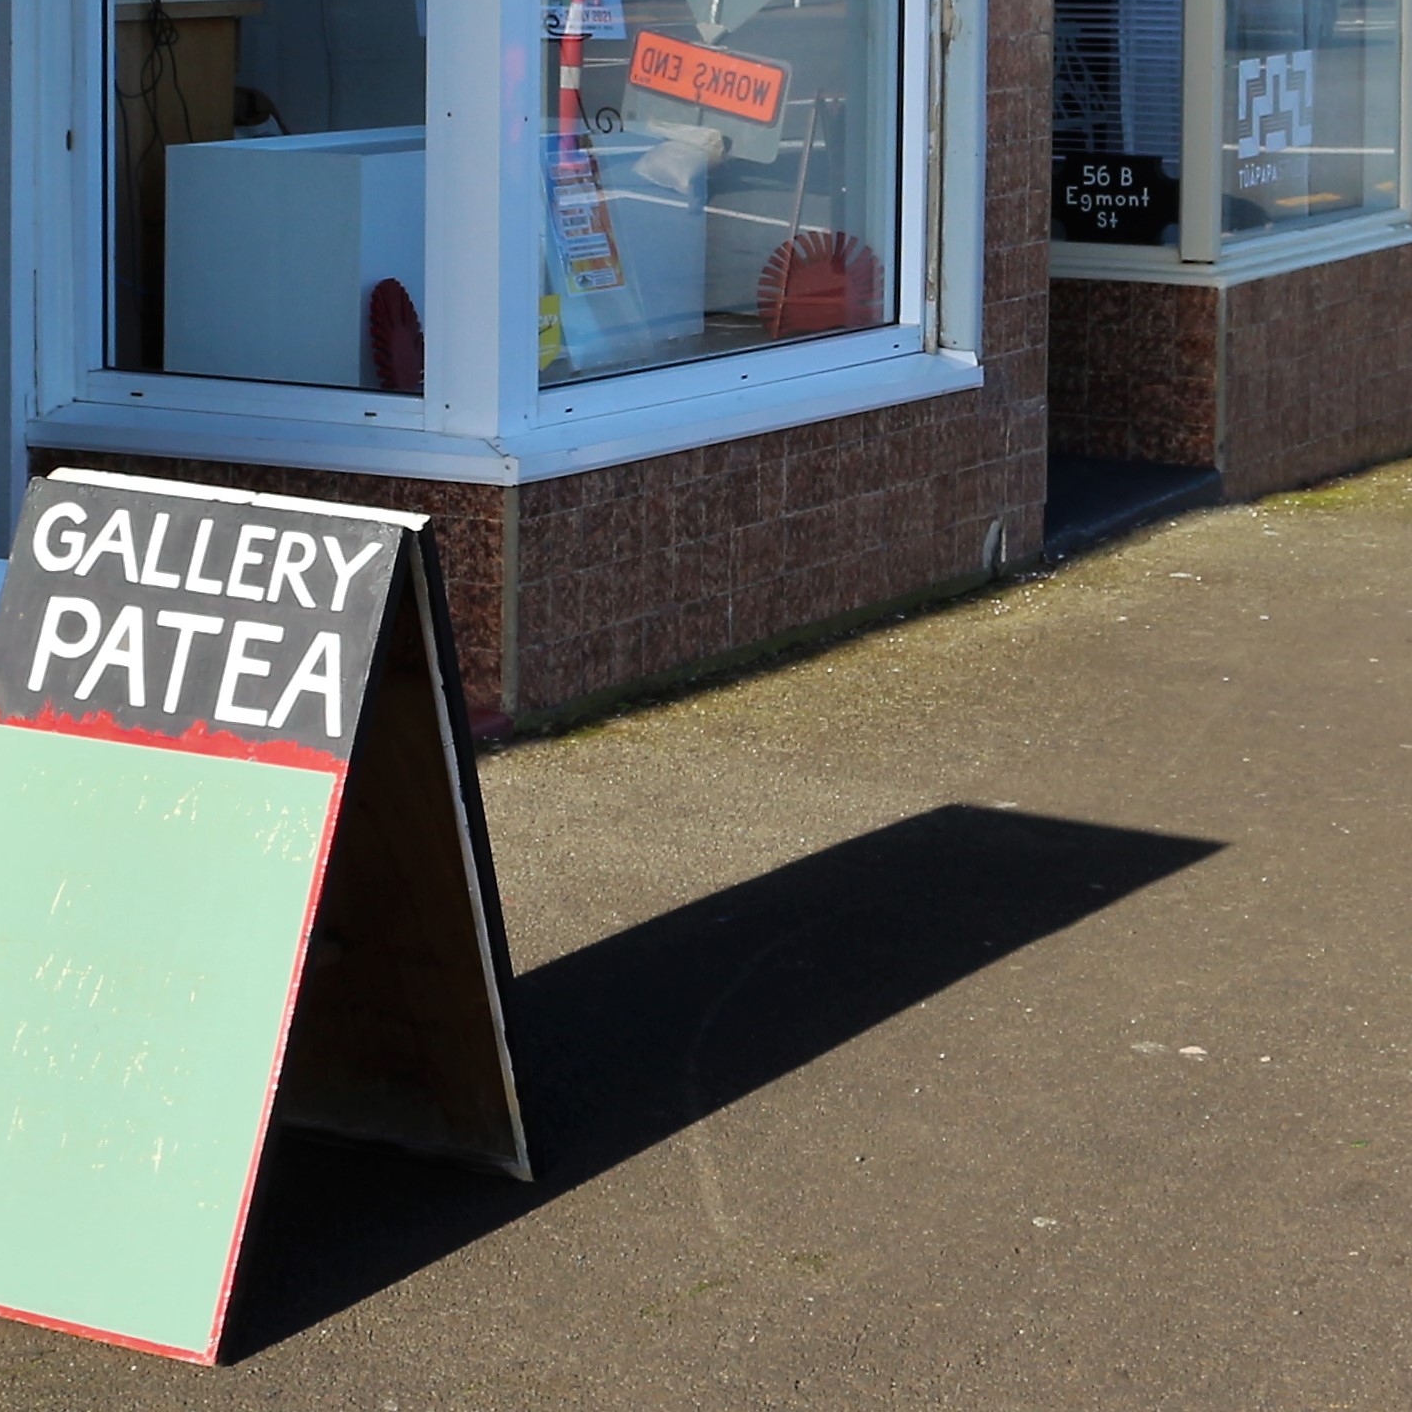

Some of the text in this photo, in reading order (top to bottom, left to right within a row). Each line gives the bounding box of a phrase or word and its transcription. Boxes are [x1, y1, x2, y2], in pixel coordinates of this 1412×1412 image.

[1083, 165, 1133, 187] 56 B
[1065, 186, 1150, 212] Egmont
[1097, 212, 1118, 228] St
[31, 500, 384, 613] GALLERY
[26, 595, 344, 738] PATEA
